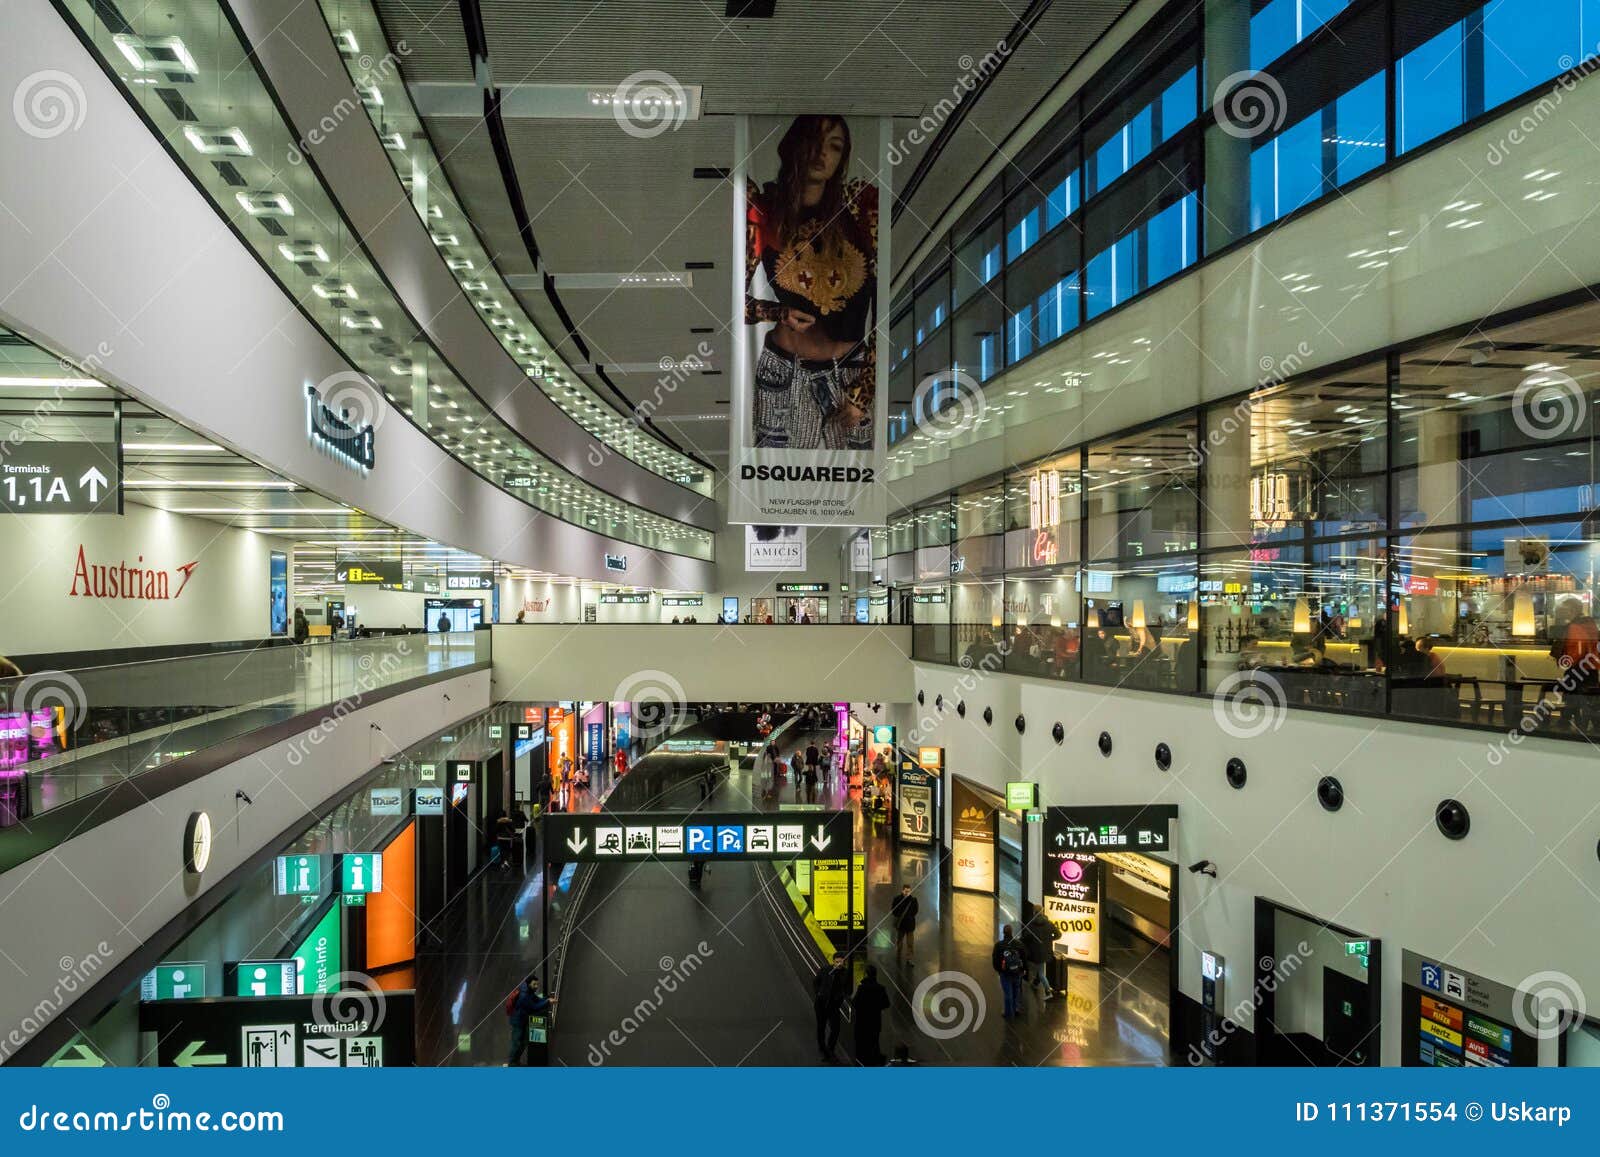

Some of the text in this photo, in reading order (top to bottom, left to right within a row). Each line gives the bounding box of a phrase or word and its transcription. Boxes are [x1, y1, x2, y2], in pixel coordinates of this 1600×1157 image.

[4, 464, 50, 473] Terminals
[741, 465, 875, 483] DSQUARED2
[3, 476, 71, 506] 1,1A
[822, 499, 845, 507] STORE
[753, 547, 799, 556] AMICIS
[69, 544, 170, 600] Austrian
[591, 724, 599, 760] SAMSUNG
[722, 835, 741, 850] P4
[778, 833, 802, 841] Office
[1067, 832, 1097, 848] 1,1A
[780, 841, 799, 849] Park
[958, 858, 975, 868] ats
[1053, 881, 1090, 892] transfer
[1068, 891, 1085, 900] city
[1049, 901, 1095, 914] TRANSFER
[1467, 978, 1480, 987] Car
[303, 1020, 368, 1033] Terminal 3
[1431, 1024, 1451, 1039] Hertz
[1468, 1020, 1499, 1038] Europcar
[1468, 1042, 1485, 1054] AVIS
